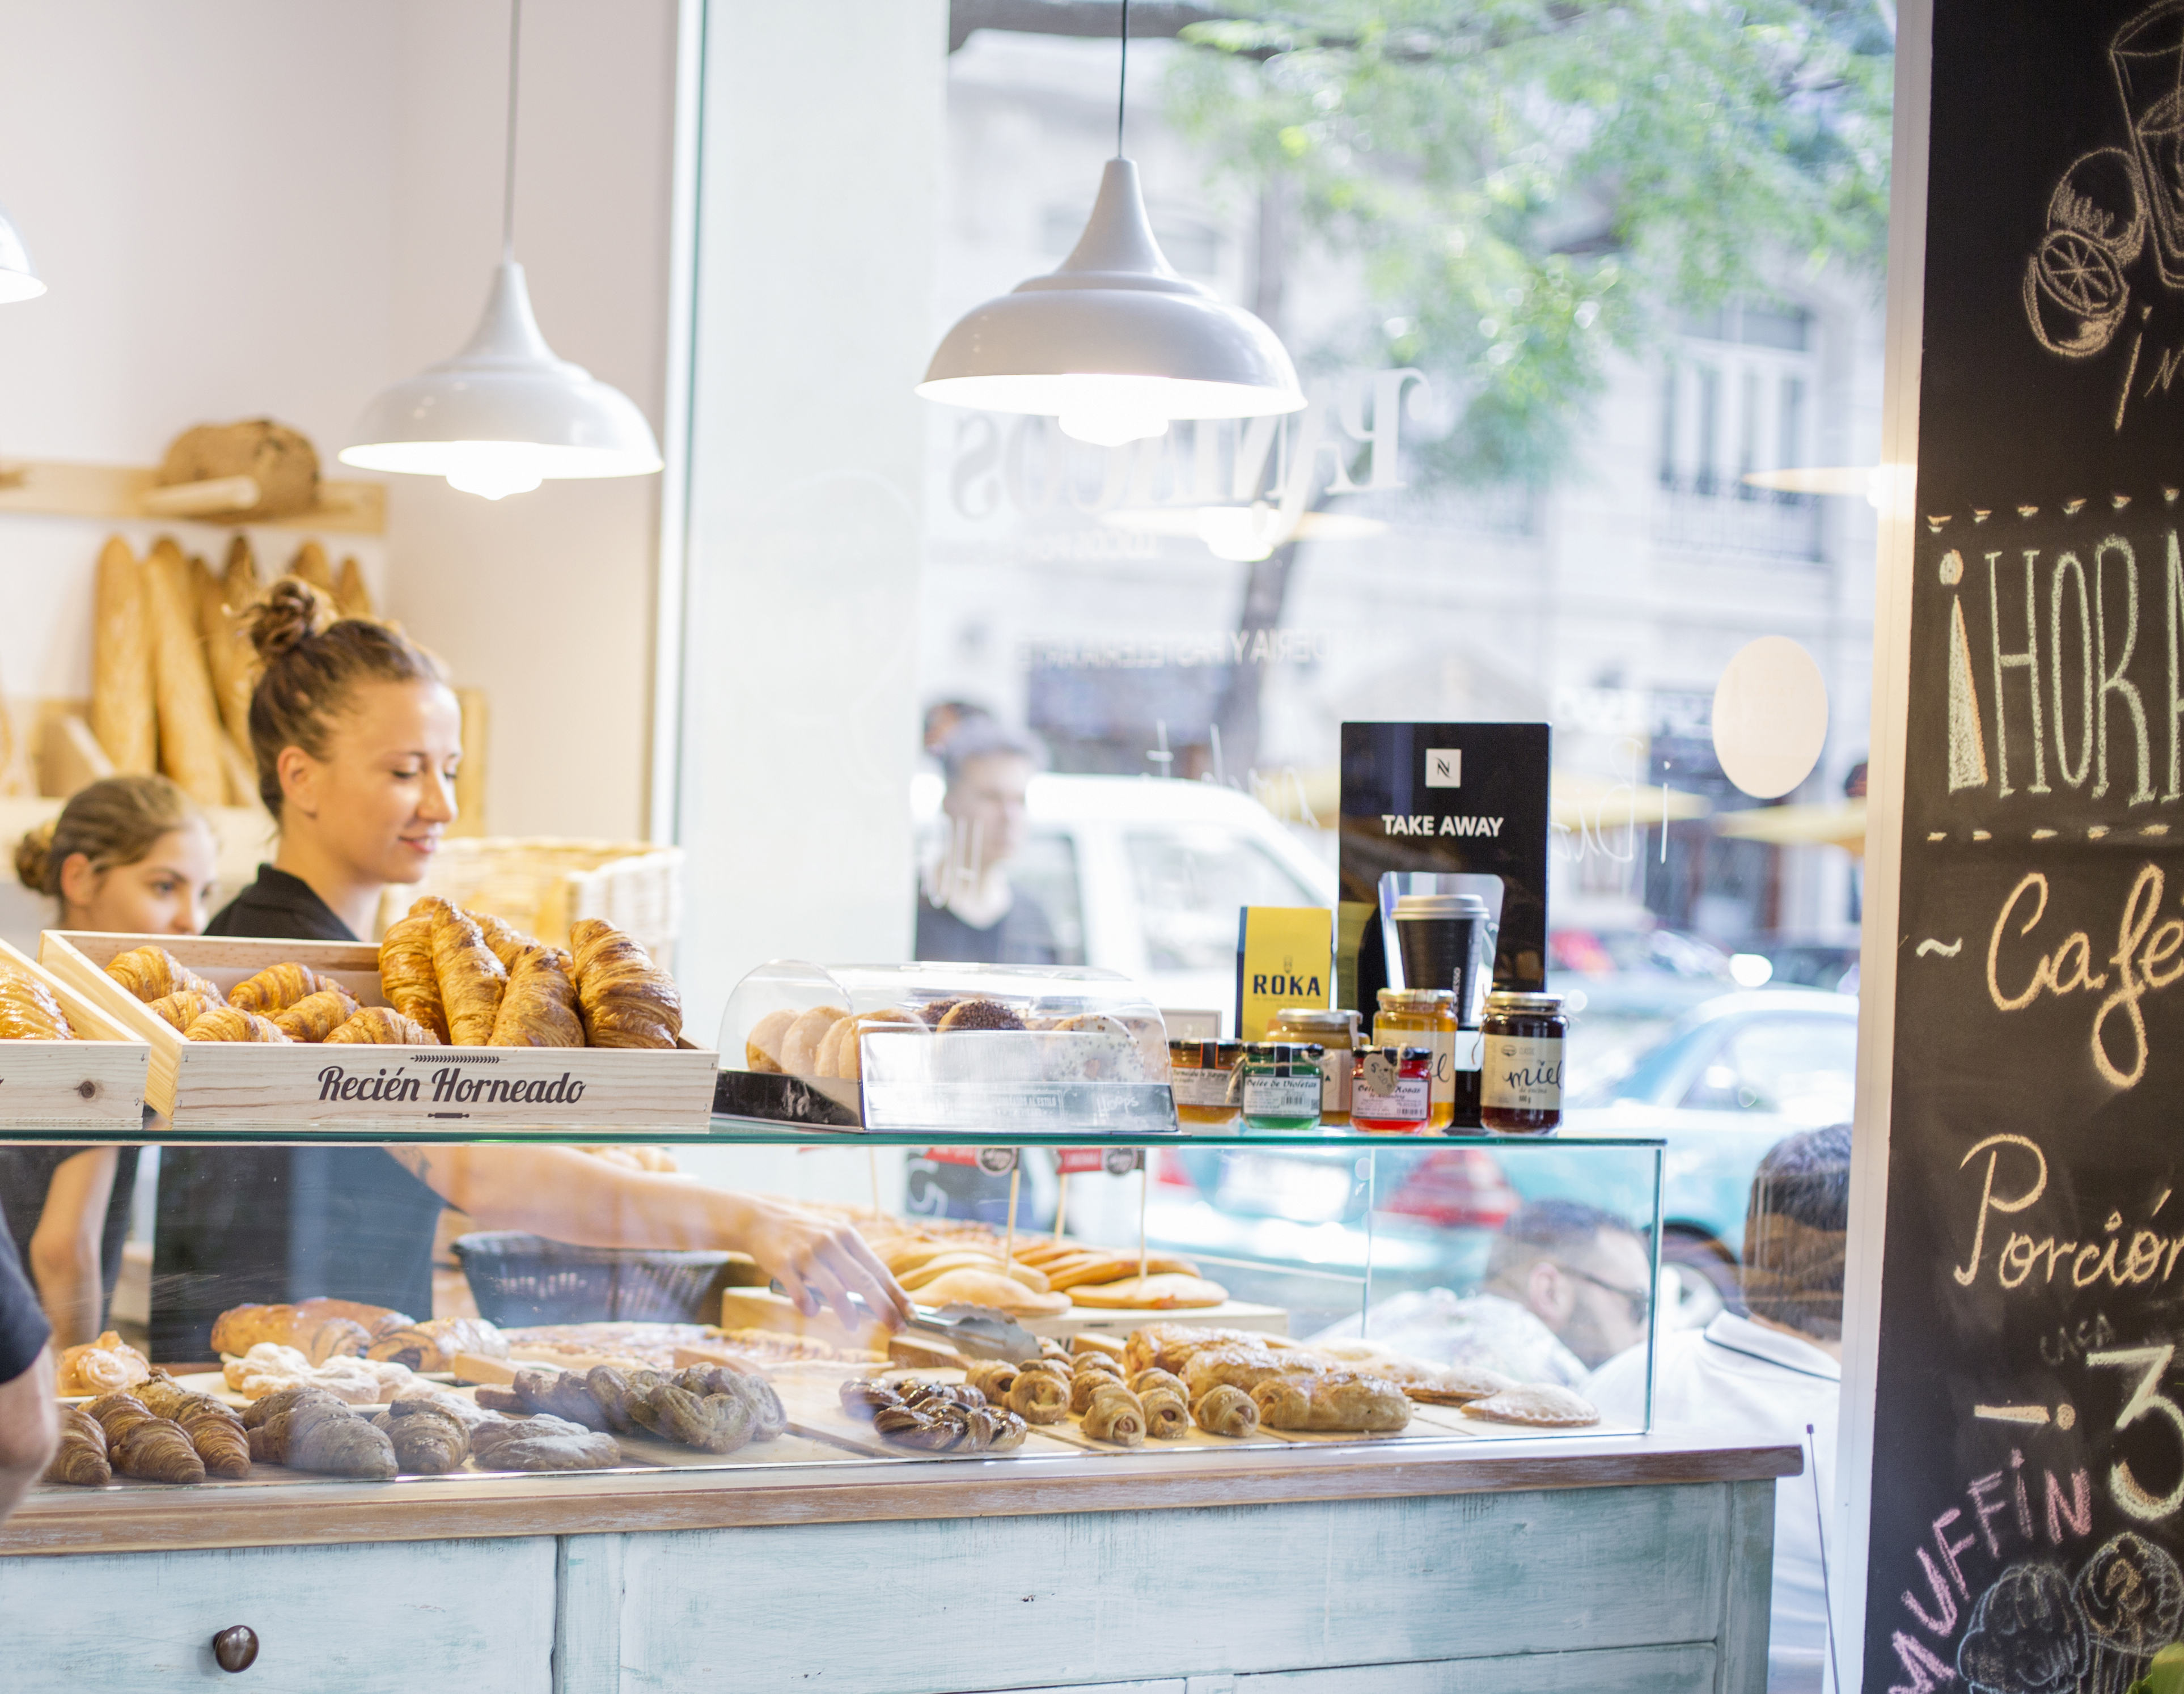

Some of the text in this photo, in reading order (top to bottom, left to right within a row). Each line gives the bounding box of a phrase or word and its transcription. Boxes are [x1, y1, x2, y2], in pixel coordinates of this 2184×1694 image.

[1381, 814, 1504, 838] TAKE AWAY
[1252, 974, 1321, 997] ROKA
[318, 1065, 587, 1104] Recién Horneado
[1502, 1059, 1563, 1090] miel
[1037, 1096, 1057, 1107] ESTILO
